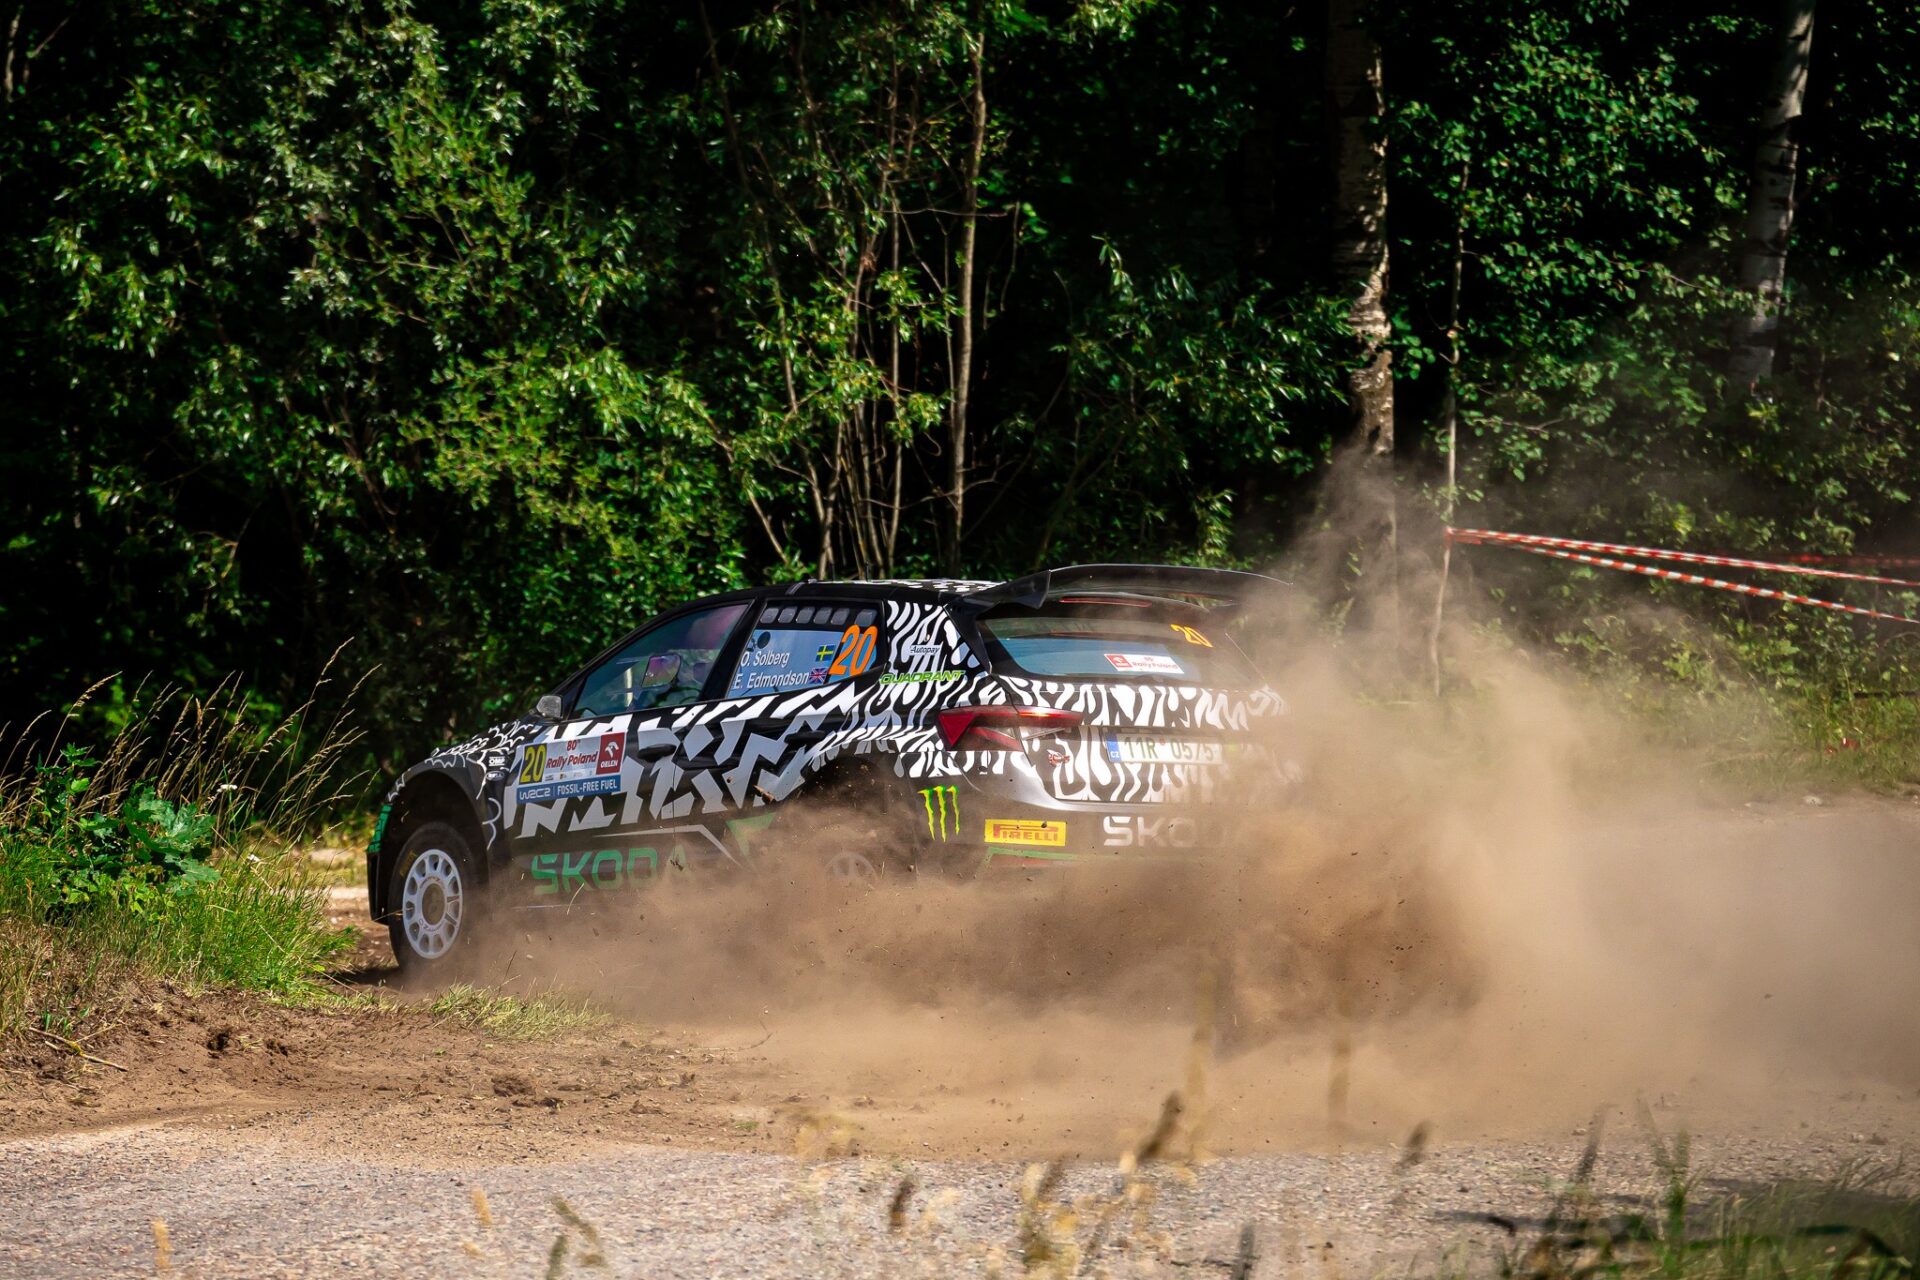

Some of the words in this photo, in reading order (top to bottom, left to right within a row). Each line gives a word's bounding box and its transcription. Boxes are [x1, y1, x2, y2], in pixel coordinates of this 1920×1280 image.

[1170, 623, 1213, 648] 20
[740, 651, 750, 667] O.
[753, 650, 790, 667] Solberg
[829, 624, 878, 676] 20
[910, 645, 940, 655] Autopay
[733, 673, 743, 689] E.
[747, 670, 810, 688] Edmondson
[879, 669, 966, 685] QUADRANT
[1110, 751, 1120, 759] CZ
[1124, 736, 1159, 759] 11R
[520, 745, 547, 783] 20
[546, 756, 568, 770] Rally
[567, 751, 599, 766] Poland
[600, 760, 619, 768] ORLEN
[520, 787, 550, 800] WRC2
[557, 781, 599, 795] FOSSIL-FREE
[600, 778, 618, 790] FUEL
[993, 823, 1059, 842] PIRELLI
